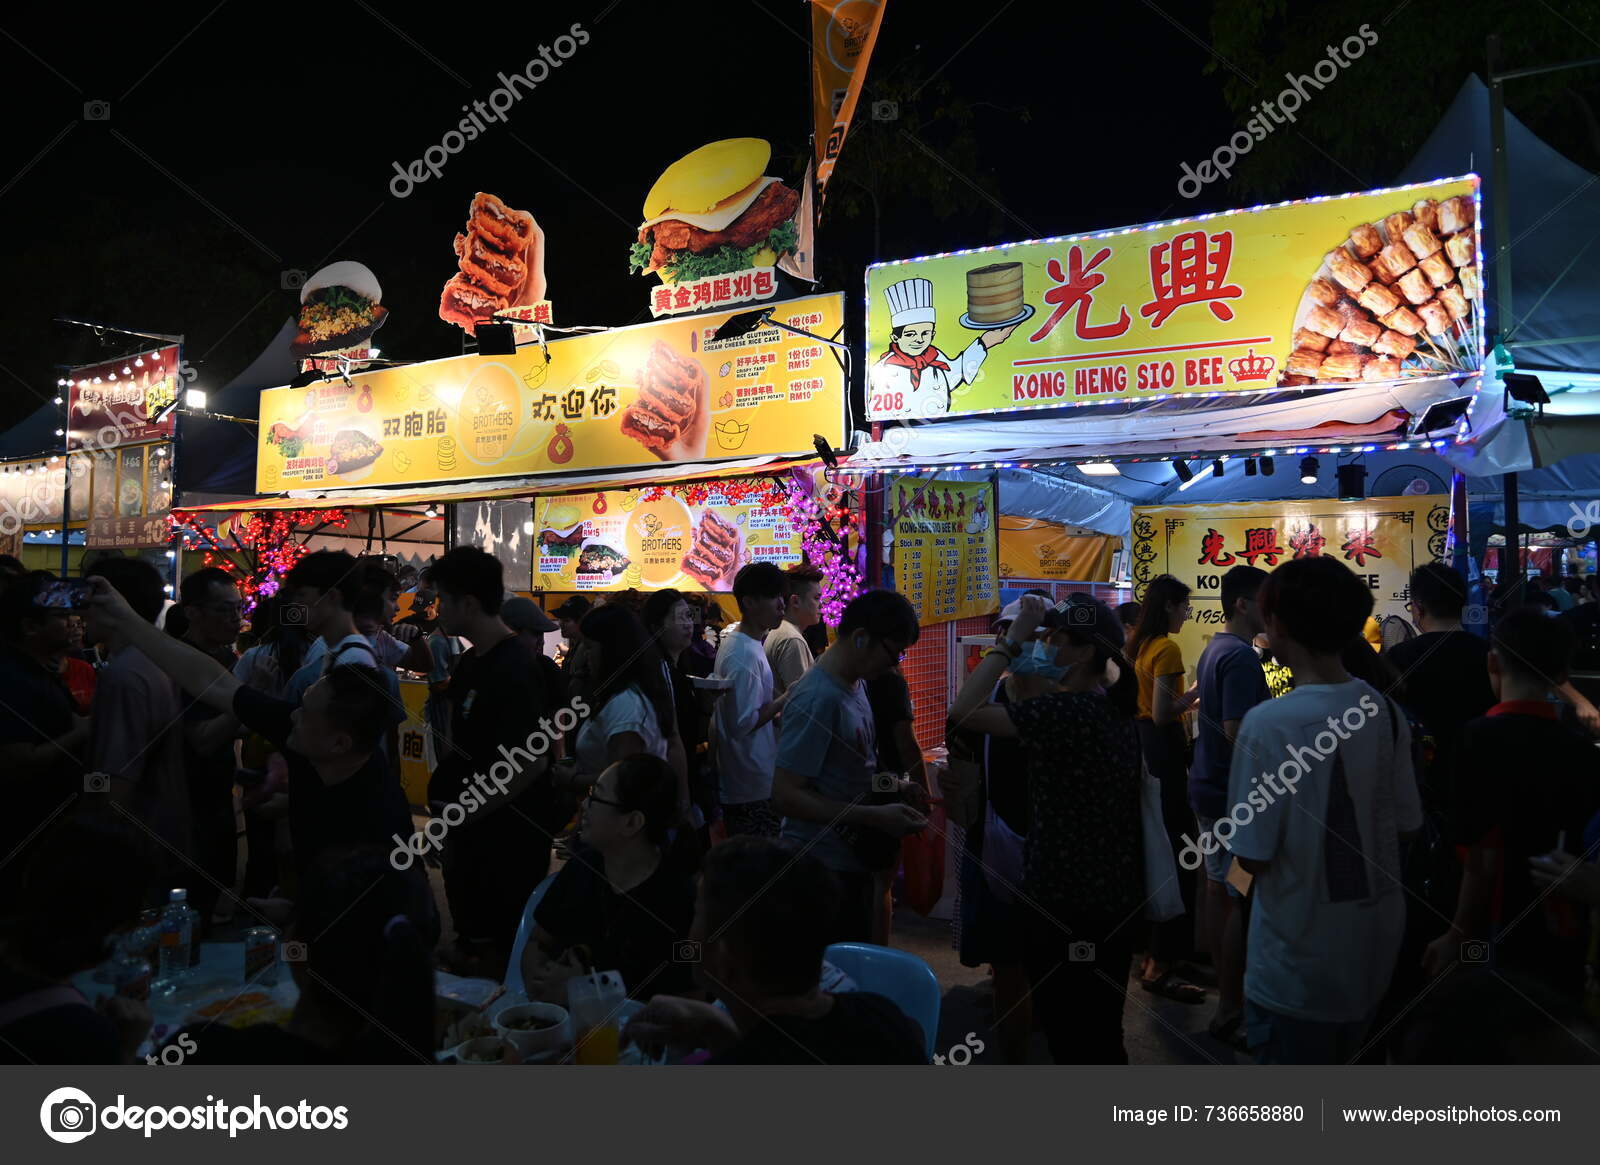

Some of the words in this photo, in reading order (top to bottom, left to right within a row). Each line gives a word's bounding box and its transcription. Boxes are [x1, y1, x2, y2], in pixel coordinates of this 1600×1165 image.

[655, 271, 773, 312] 黄金鸡腿刈包
[1029, 231, 1242, 342] 光興
[764, 335, 780, 343] CAKE
[788, 359, 810, 369] RM15
[1013, 371, 1065, 400] KONG
[1075, 366, 1127, 395] HENG
[1138, 361, 1175, 390] SIO
[1185, 356, 1223, 387] BEE
[532, 386, 616, 421] 欢迎你
[790, 392, 811, 401] RM10
[873, 392, 904, 411] 208
[383, 408, 447, 437] 双胞胎
[473, 411, 513, 430] BROTHERS
[115, 535, 135, 545] Below
[583, 528, 600, 537] RM15
[641, 538, 682, 551] BROTHERS
[1040, 559, 1072, 567] BROTHERS
[403, 731, 423, 758] 胞
